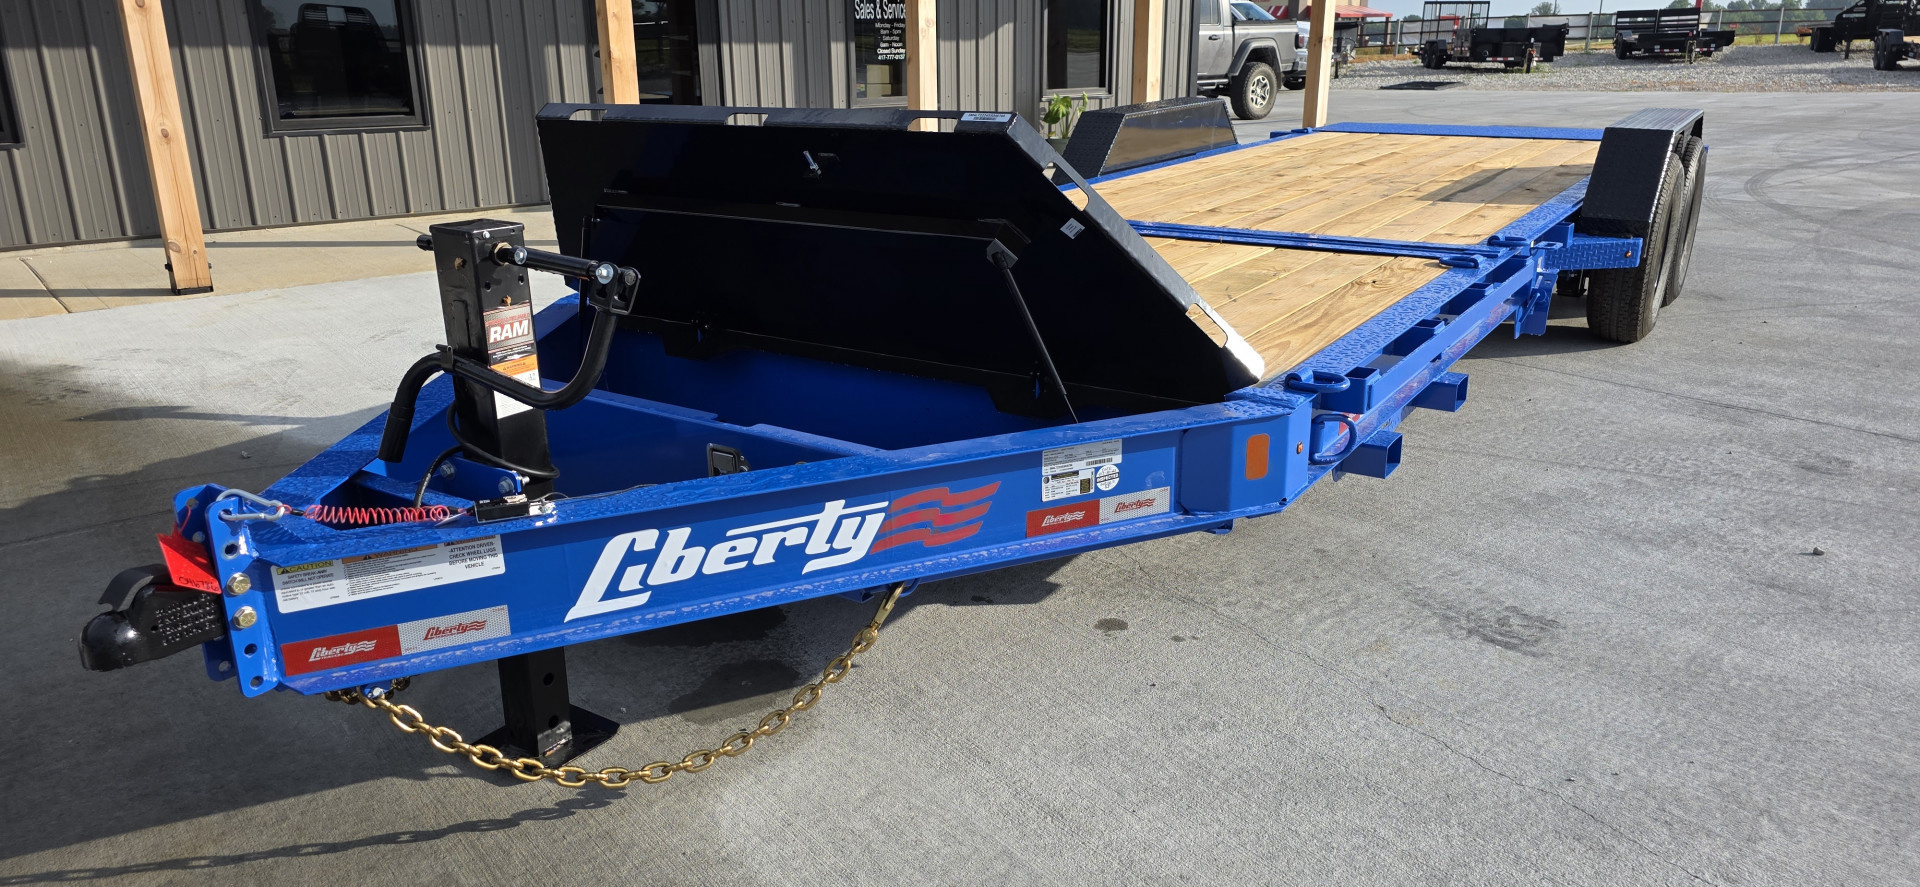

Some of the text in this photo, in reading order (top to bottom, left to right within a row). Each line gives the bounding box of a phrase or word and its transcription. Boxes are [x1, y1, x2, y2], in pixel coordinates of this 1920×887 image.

[855, 0, 874, 19] Sales
[876, 0, 882, 19] &
[490, 320, 529, 343] RAM
[1114, 499, 1145, 513] Liberty
[1041, 512, 1073, 527] Liberty
[289, 560, 333, 572] CAUTION
[465, 561, 485, 569] VEHICLE
[564, 499, 889, 623] Liberty
[423, 623, 468, 641] Liberty
[309, 642, 358, 662] Liberty
